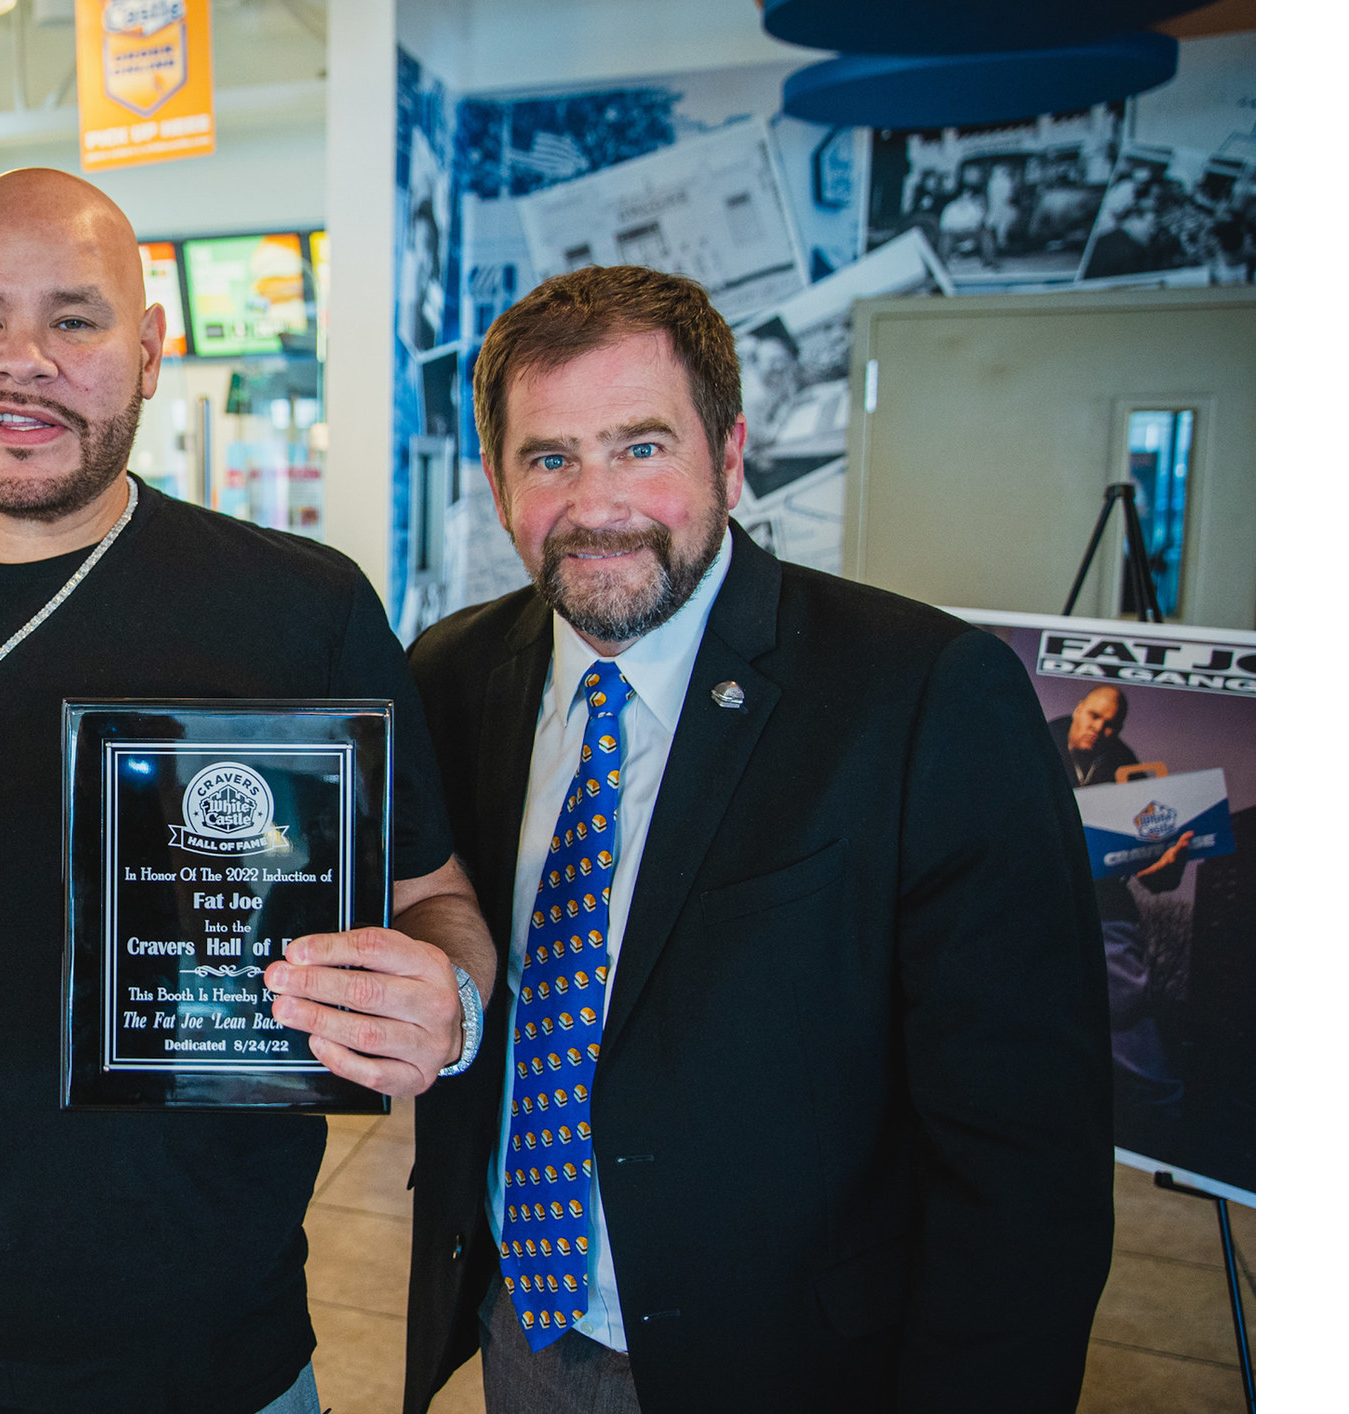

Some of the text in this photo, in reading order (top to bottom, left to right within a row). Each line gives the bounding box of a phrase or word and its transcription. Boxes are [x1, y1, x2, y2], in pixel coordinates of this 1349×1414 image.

[1047, 636, 1182, 665] FAT
[1042, 659, 1106, 677] DA
[197, 773, 260, 797] CRAVERS
[207, 799, 251, 815] White
[206, 812, 252, 826] Castle
[187, 836, 268, 851] HALL OF FAME
[125, 866, 333, 883] In Honor Of The 2022 Induction of
[193, 892, 263, 910] Fat Joe
[204, 919, 252, 934] Into the
[126, 936, 195, 957] Cravers
[206, 937, 242, 957] Hall
[252, 938, 272, 957] of
[128, 986, 154, 1002] This
[157, 987, 195, 1002] Booth
[198, 988, 209, 1002] Is
[212, 987, 258, 1005] Hereby
[123, 1011, 148, 1030] The
[153, 1011, 176, 1030] Fat
[181, 1011, 204, 1030] Joe
[164, 1039, 290, 1053] Dedicated 8/24/22
